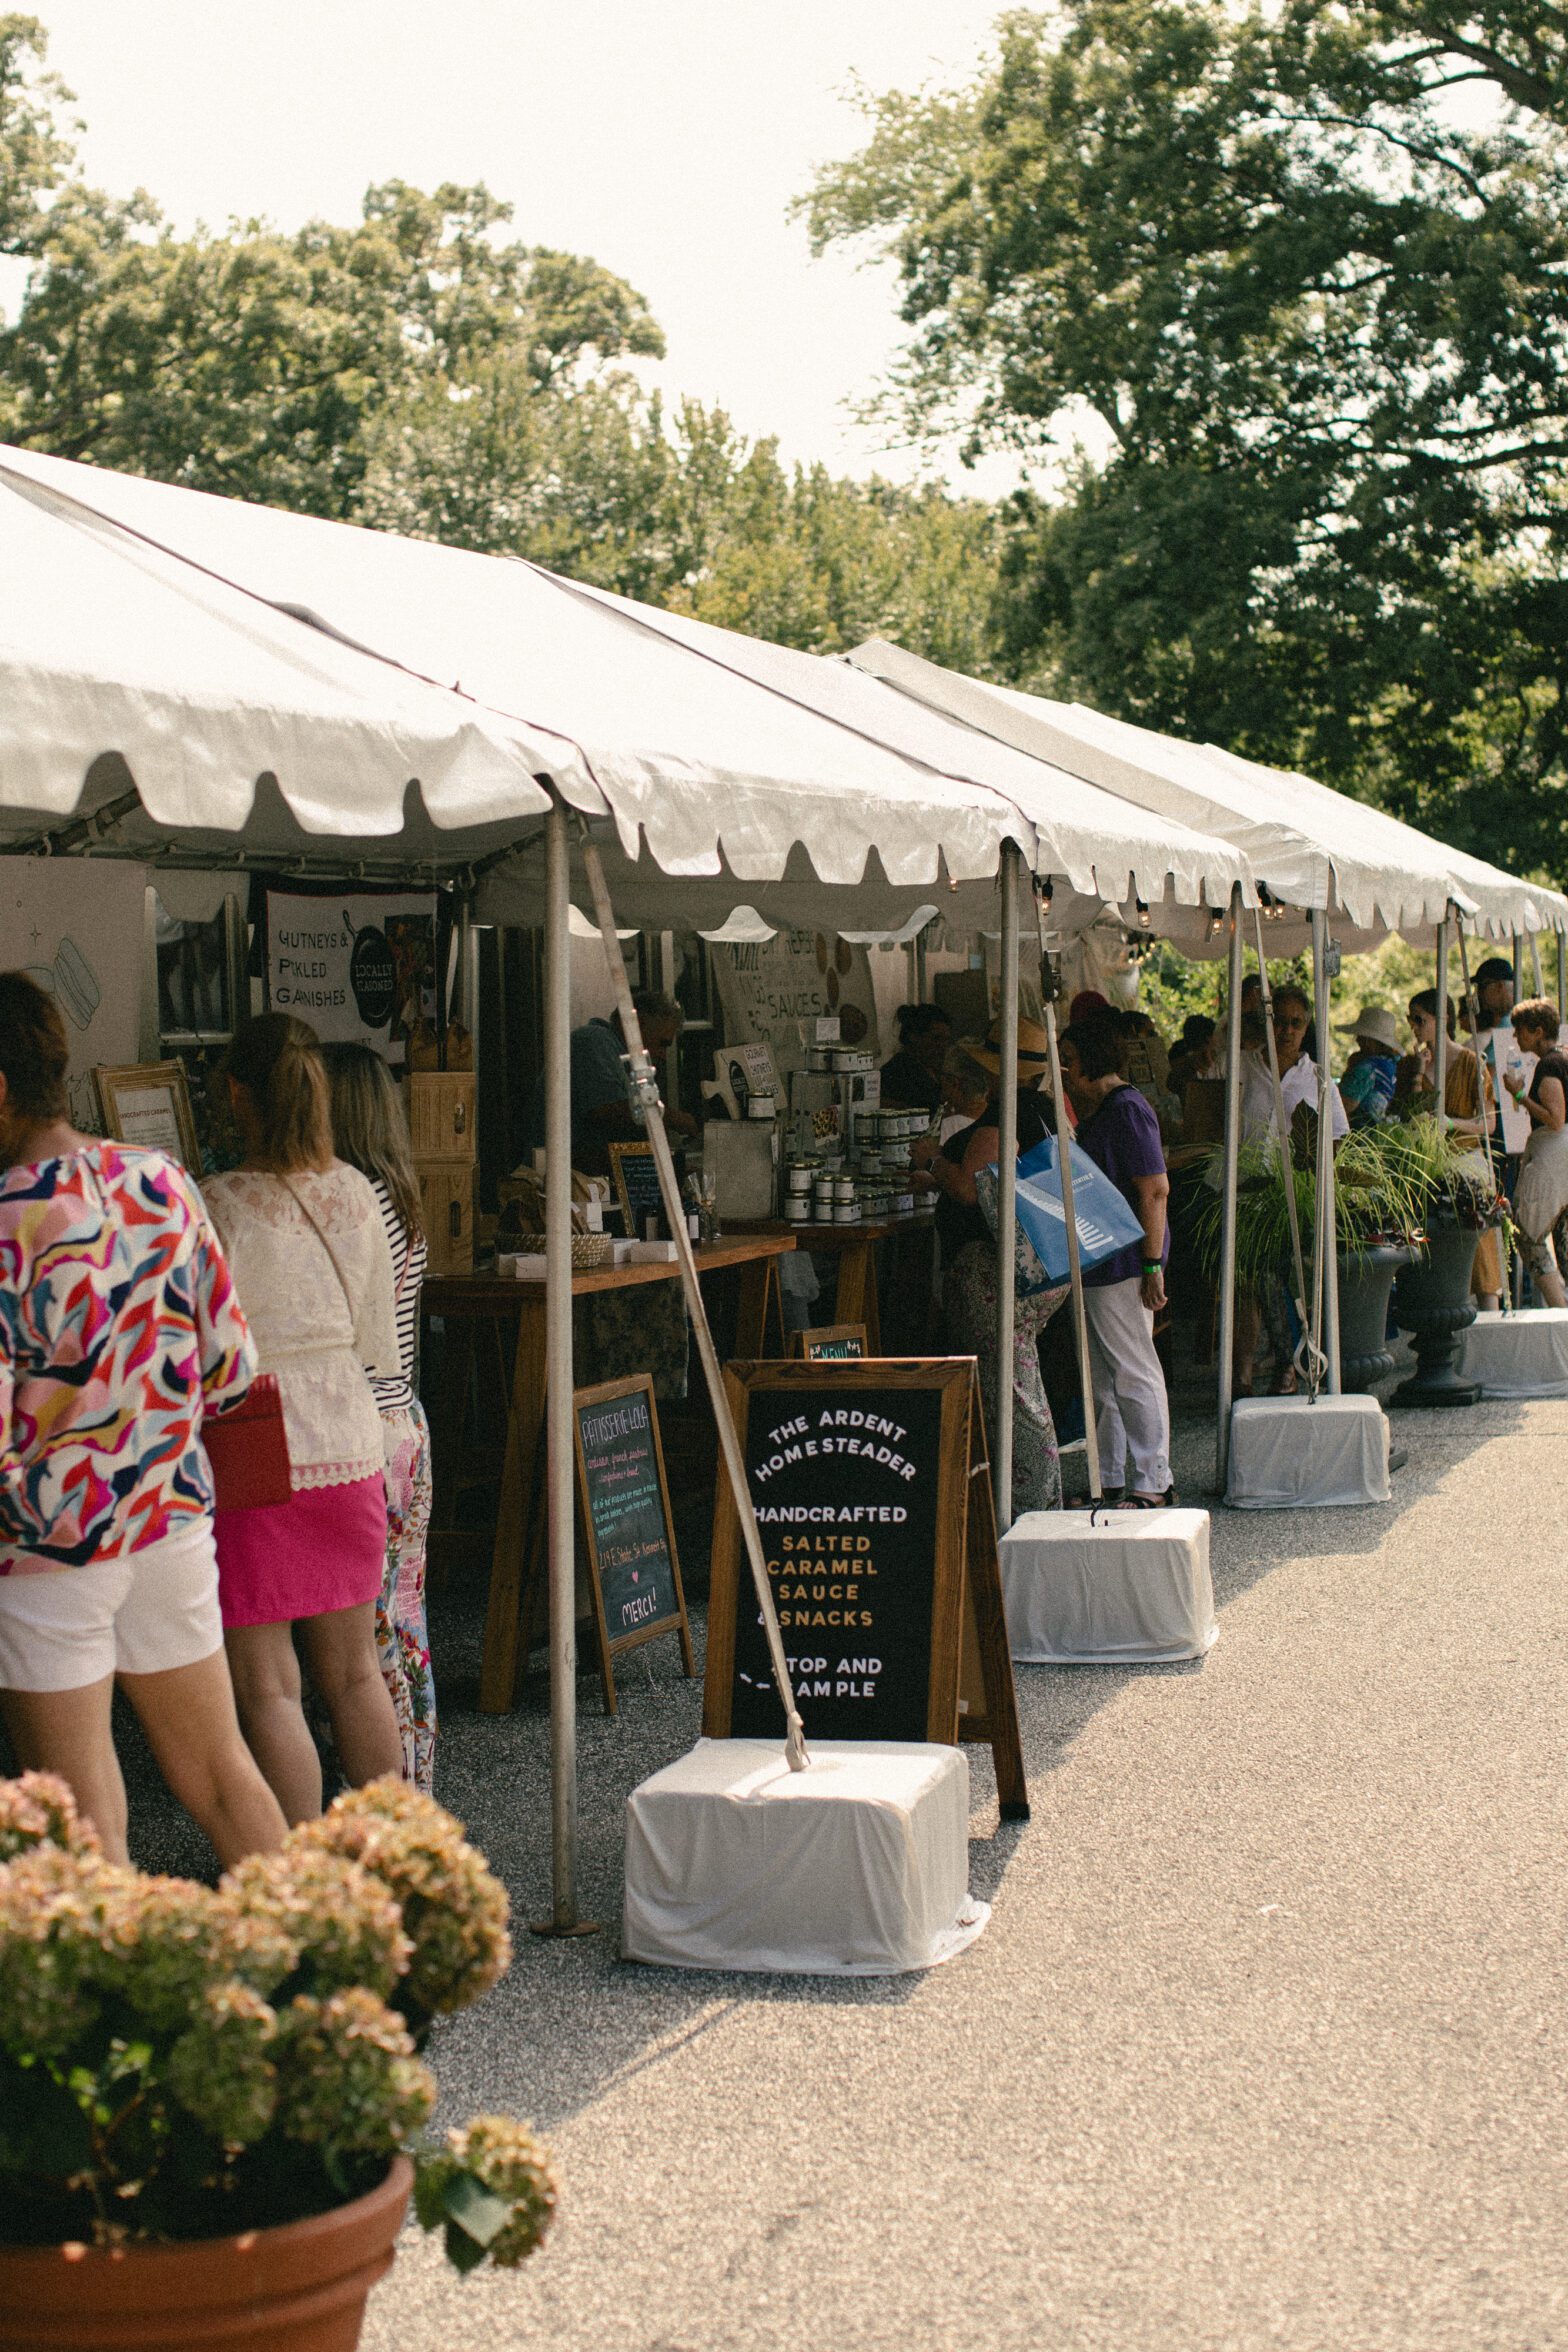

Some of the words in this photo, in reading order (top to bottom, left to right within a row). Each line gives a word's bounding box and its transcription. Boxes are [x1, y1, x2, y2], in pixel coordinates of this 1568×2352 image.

[355, 964, 392, 977] LOCALLY
[628, 1404, 650, 1429] LOLA
[768, 1416, 810, 1445] THE
[819, 1410, 907, 1442] ARDENT
[754, 1437, 917, 1482] HOMESTEADER
[752, 1506, 908, 1523] HANDCRAFTED
[782, 1535, 871, 1551] SALTED
[767, 1560, 878, 1575] CARAMEL
[779, 1584, 859, 1600] SAUCE
[622, 1586, 657, 1626] MERCI!
[780, 1611, 873, 1626] SNACKS
[772, 1657, 827, 1674] TOP
[836, 1657, 882, 1674] AND
[777, 1681, 876, 1698] AMPLE
